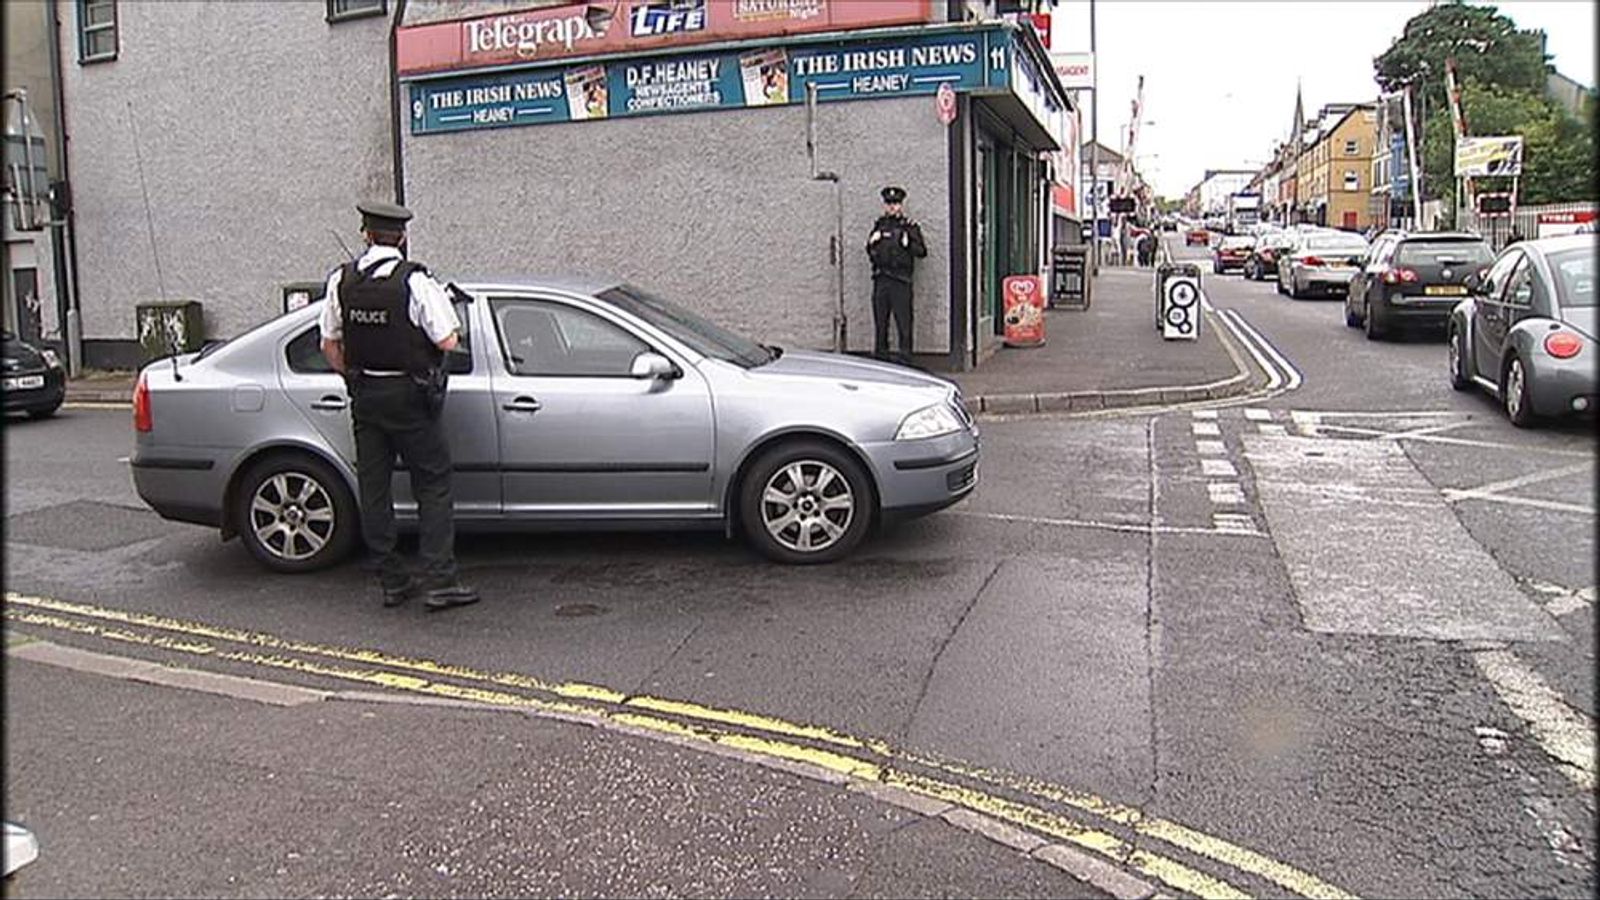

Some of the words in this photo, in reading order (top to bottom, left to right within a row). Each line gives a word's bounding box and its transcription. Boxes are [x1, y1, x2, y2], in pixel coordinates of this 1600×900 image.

[634, 5, 703, 36] LIFE
[793, 55, 838, 75] THE
[844, 49, 904, 70] IRISH
[911, 43, 976, 64] NEWS
[990, 48, 1005, 70] 11
[635, 80, 711, 97] NEWSAGENTS
[852, 74, 910, 93] HEANEY
[430, 92, 464, 109] THE
[467, 86, 511, 104] IRISH
[514, 80, 562, 99] NEWS
[627, 91, 721, 110] CONFECTIONERS
[413, 101, 424, 119] 9
[472, 107, 514, 124] HEANEY
[350, 309, 387, 323] POLICE
